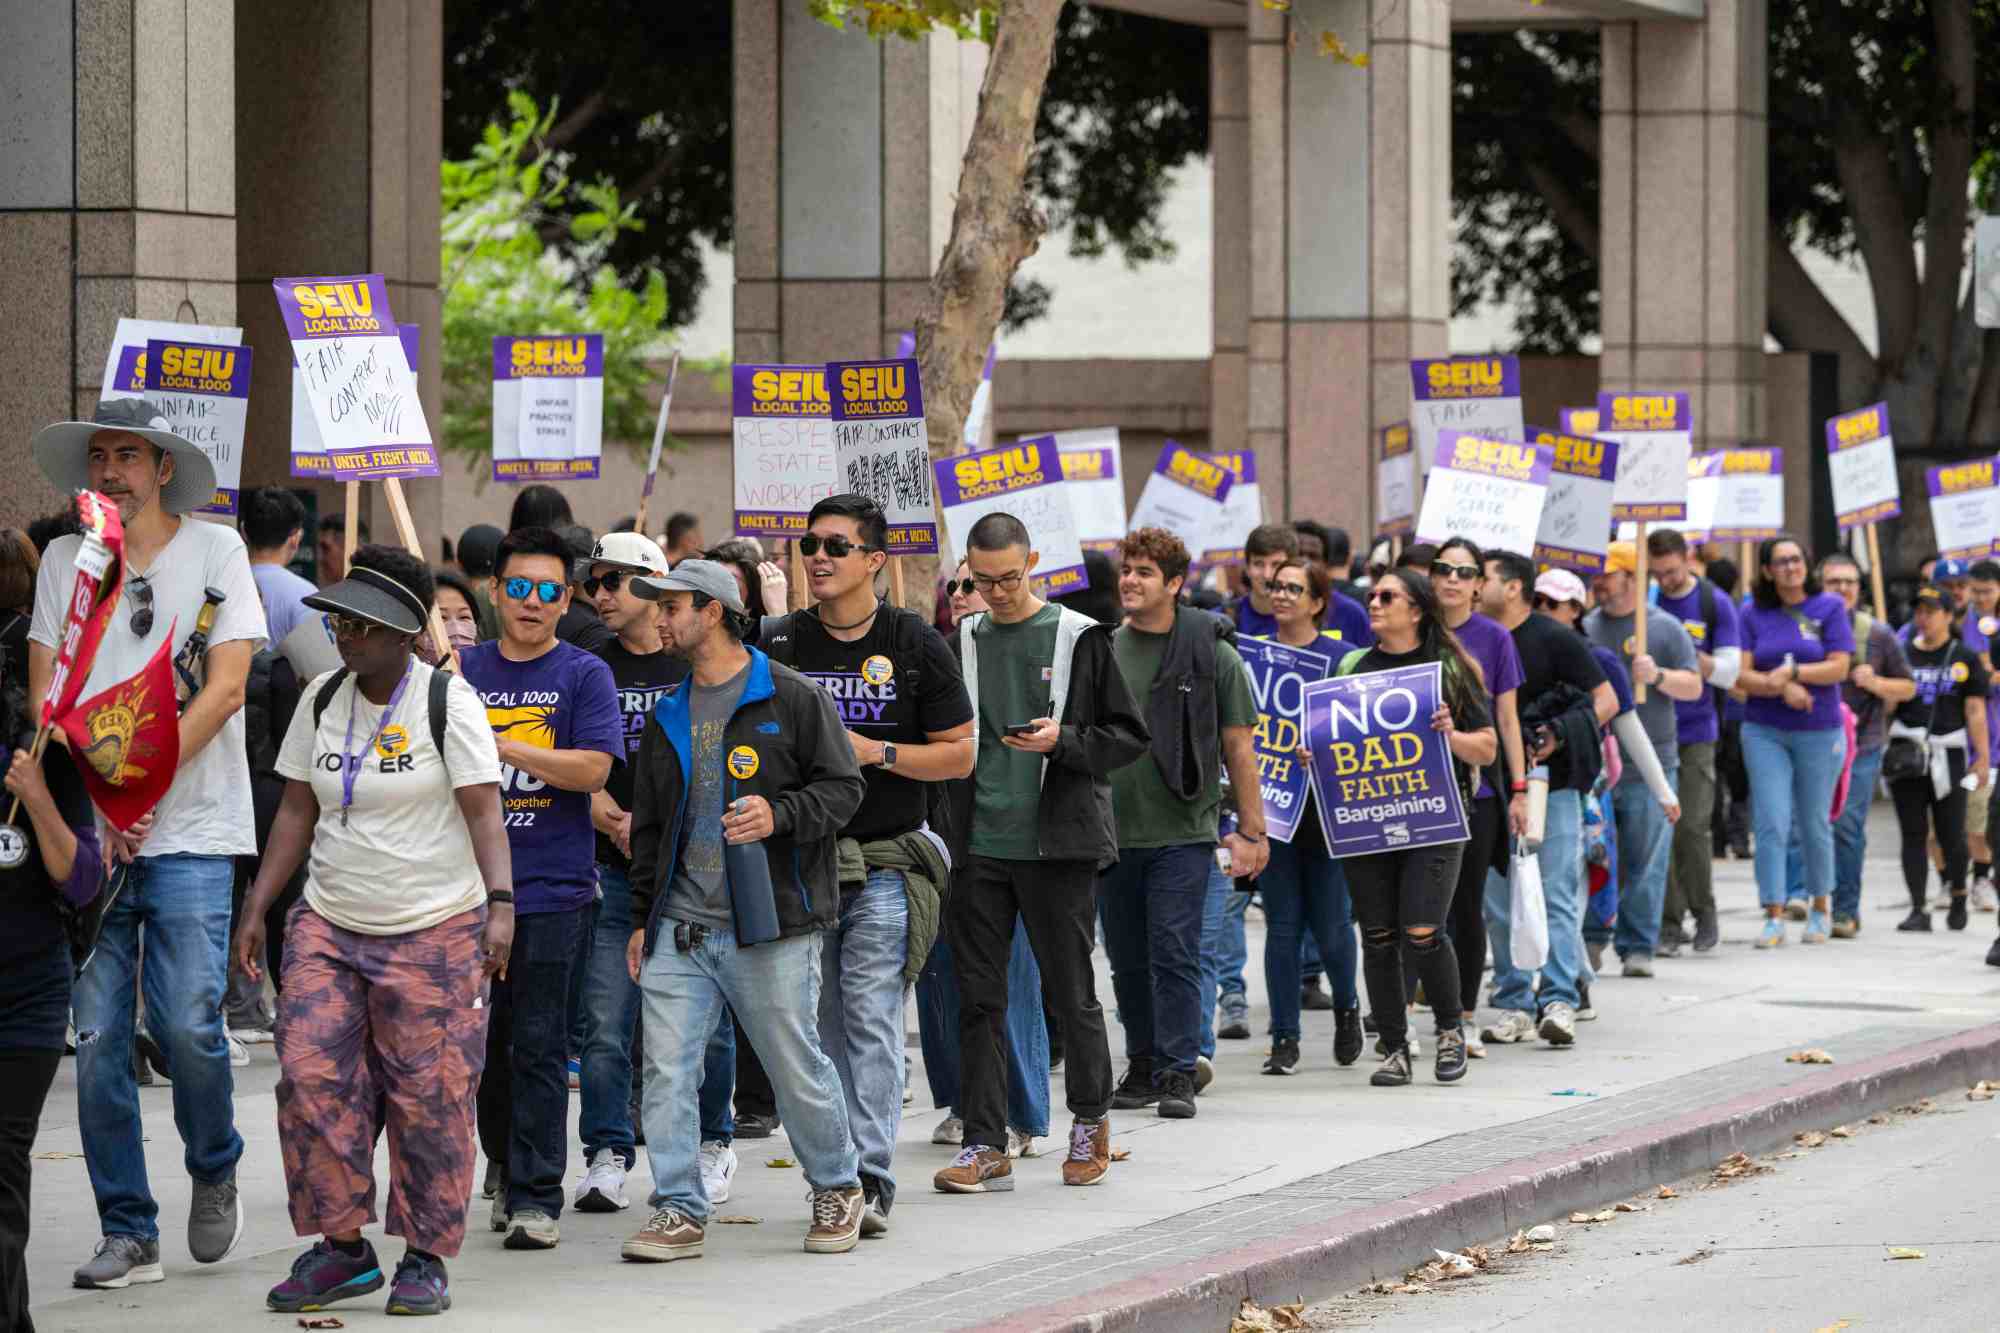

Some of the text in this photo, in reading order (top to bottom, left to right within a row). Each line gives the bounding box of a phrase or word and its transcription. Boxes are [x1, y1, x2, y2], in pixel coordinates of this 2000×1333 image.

[294, 281, 373, 318] SEIU
[304, 317, 380, 333] LOCAL 1000
[161, 346, 236, 380] SEIU
[304, 339, 345, 390] FAIR
[511, 339, 587, 367] SEIU
[159, 375, 232, 393] LOCAL 1000
[511, 363, 586, 377] LOCAL 1000
[840, 366, 905, 401] SEIU
[1427, 360, 1503, 388] SEIU
[752, 402, 831, 414] LOCAL 100
[844, 401, 908, 416] LOCAL 1000
[1611, 396, 1677, 421] SEIU
[738, 420, 826, 448] RESPE
[835, 421, 921, 451] FAIR CONTRACT
[333, 450, 433, 470] UNITE. FIGHT. WIN.
[954, 444, 1040, 489] SEIU
[1453, 436, 1536, 470] SEIU
[959, 470, 1044, 500] LOCAL 1000
[739, 514, 781, 529] UNITE.
[910, 527, 934, 543] WIN.
[480, 691, 560, 706] OCAL 1000
[1330, 687, 1418, 740] NO
[1252, 713, 1299, 753] AD
[1329, 732, 1424, 776] BAD
[1340, 769, 1430, 802] FAITH
[506, 796, 552, 810] ogether
[1334, 796, 1447, 825] Bargaining
